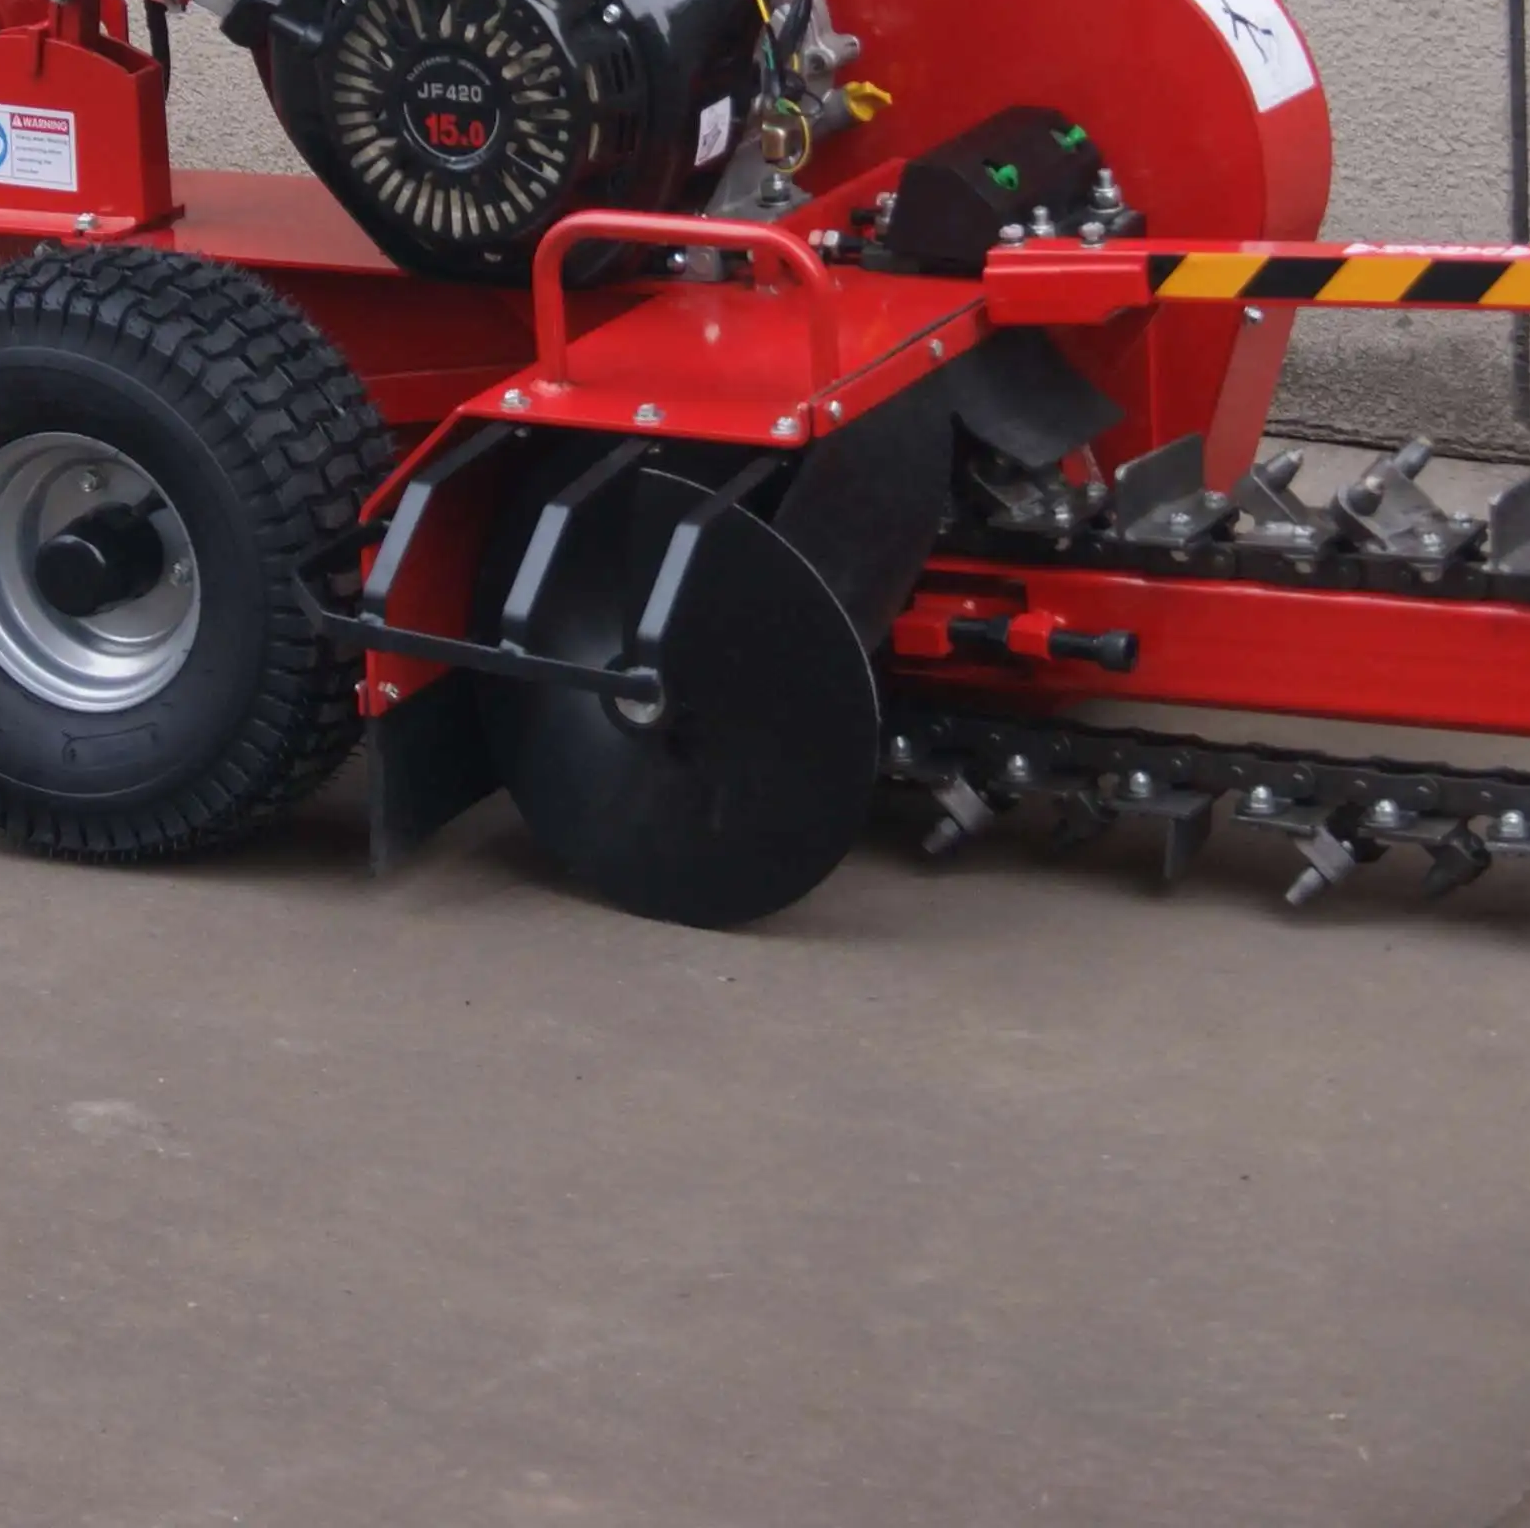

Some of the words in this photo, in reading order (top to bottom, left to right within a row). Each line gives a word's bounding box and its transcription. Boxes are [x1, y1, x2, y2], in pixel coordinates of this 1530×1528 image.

[417, 83, 482, 103] JF420
[23, 116, 67, 132] WARNING
[425, 112, 484, 148] 15.0
